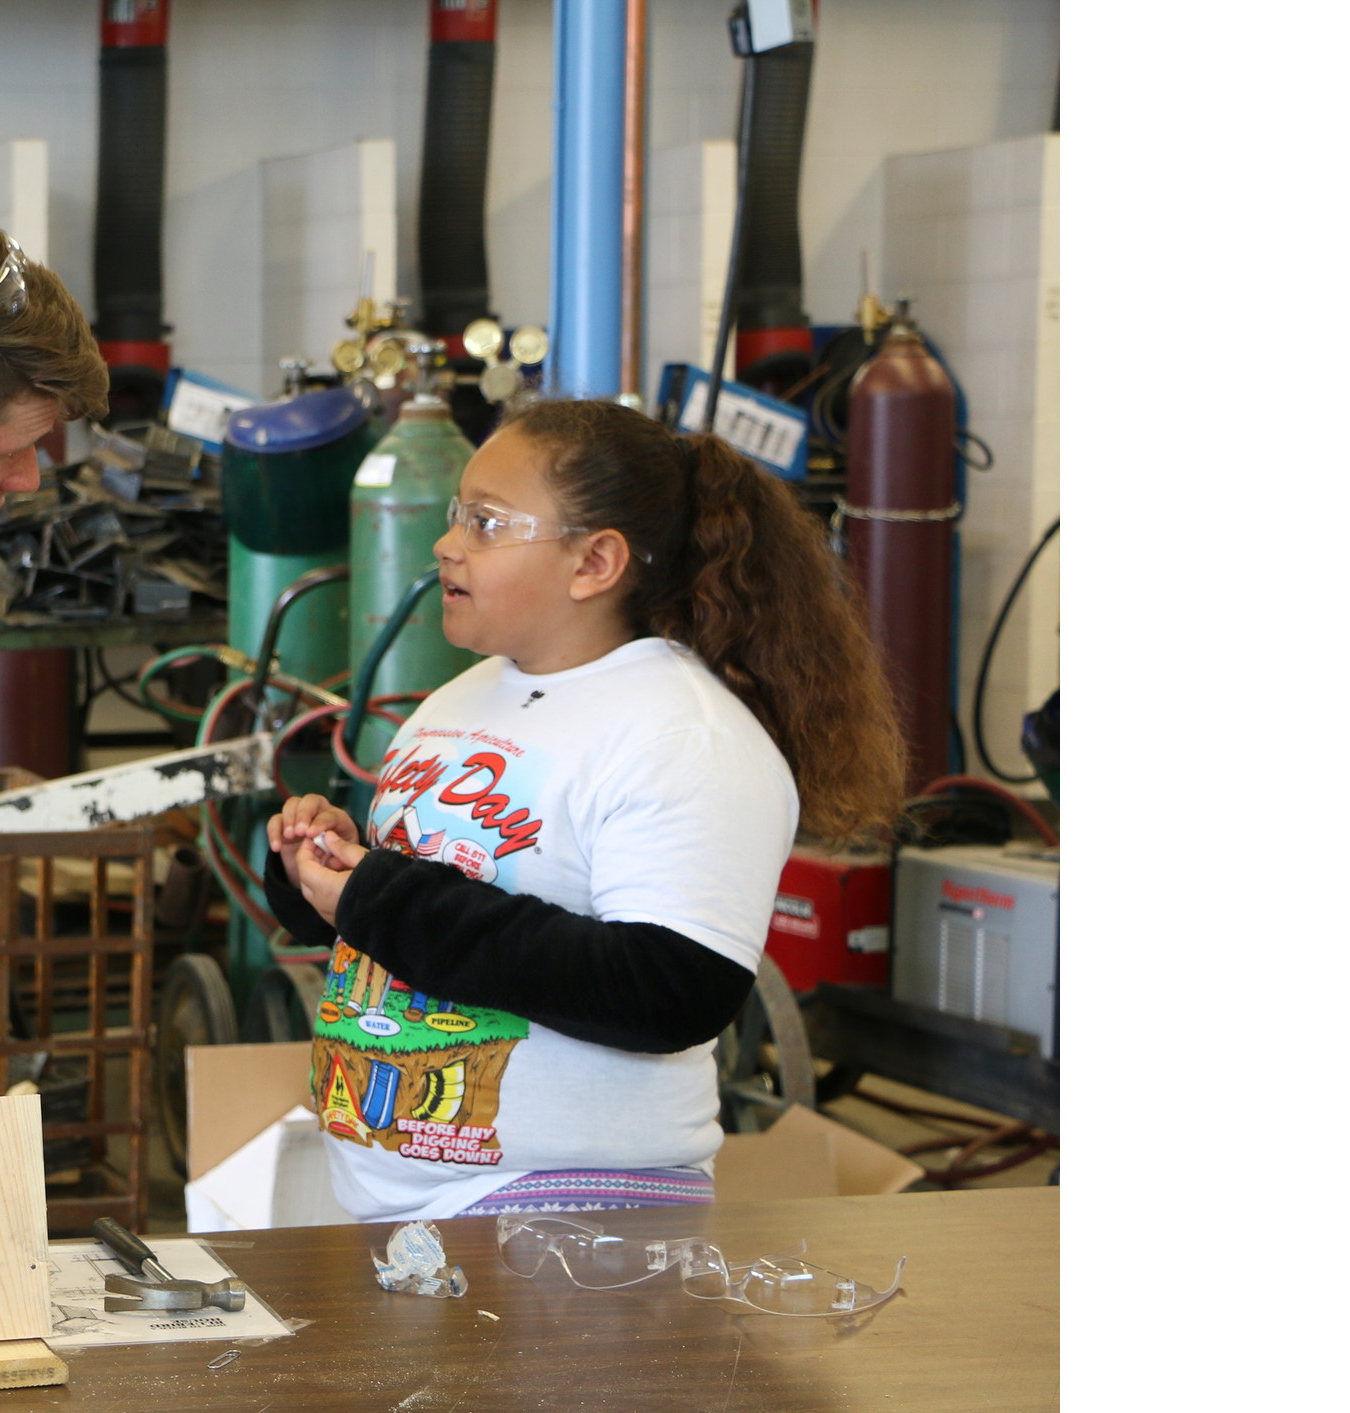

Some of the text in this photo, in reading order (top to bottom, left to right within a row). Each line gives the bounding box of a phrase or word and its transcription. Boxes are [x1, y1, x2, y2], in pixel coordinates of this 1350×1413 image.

[438, 752, 543, 860] Day
[454, 853, 481, 870] BEFORE
[365, 1018, 470, 1031] WATER PIPELINE
[397, 1118, 496, 1140] BEFORE ANY
[411, 1133, 481, 1151] DIGGING
[400, 1143, 502, 1164] GOES DOWN!
